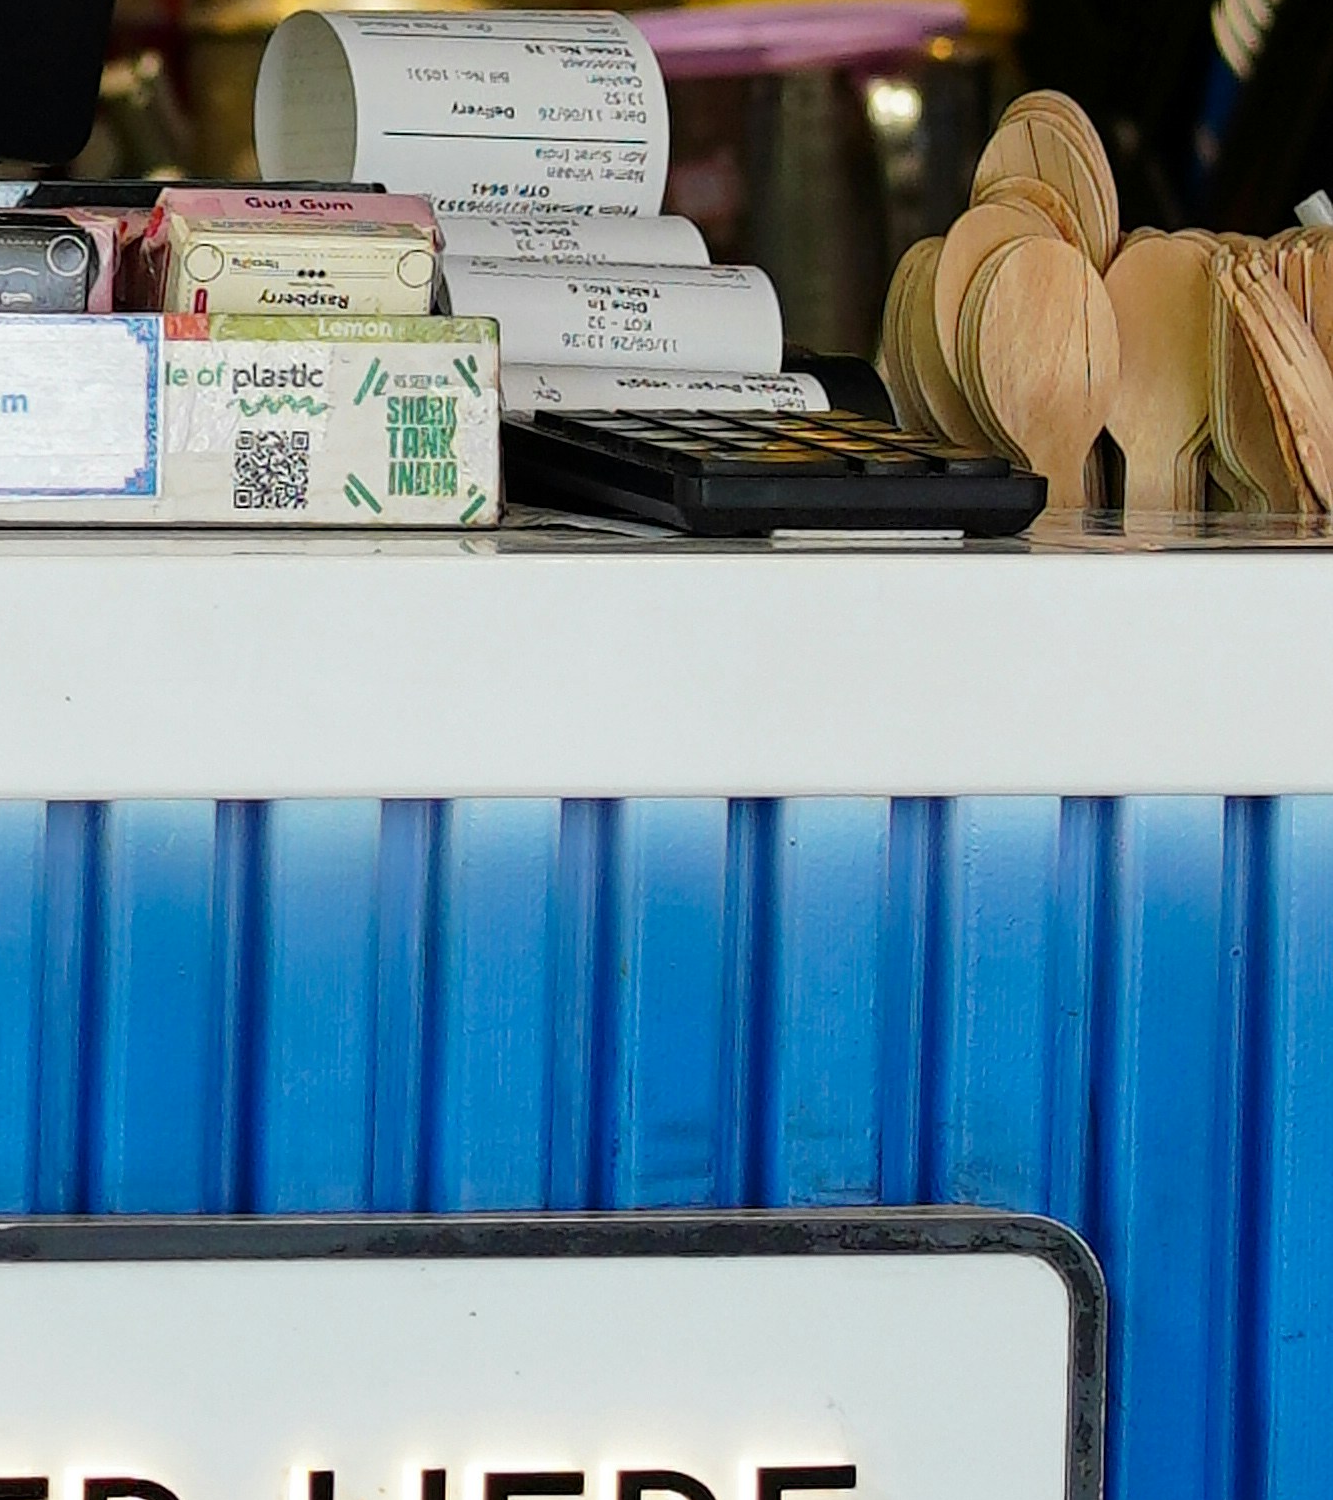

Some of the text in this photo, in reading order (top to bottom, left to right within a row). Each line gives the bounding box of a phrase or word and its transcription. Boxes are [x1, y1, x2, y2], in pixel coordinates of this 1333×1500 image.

[451, 103, 515, 120] Delivery
[245, 196, 355, 212] Gud Gum
[259, 289, 350, 310] Raspberry
[318, 319, 392, 337] Lemon
[197, 360, 227, 386] of
[232, 362, 325, 393] plastic
[386, 427, 457, 459] TANK
[387, 462, 458, 497] INDIA
